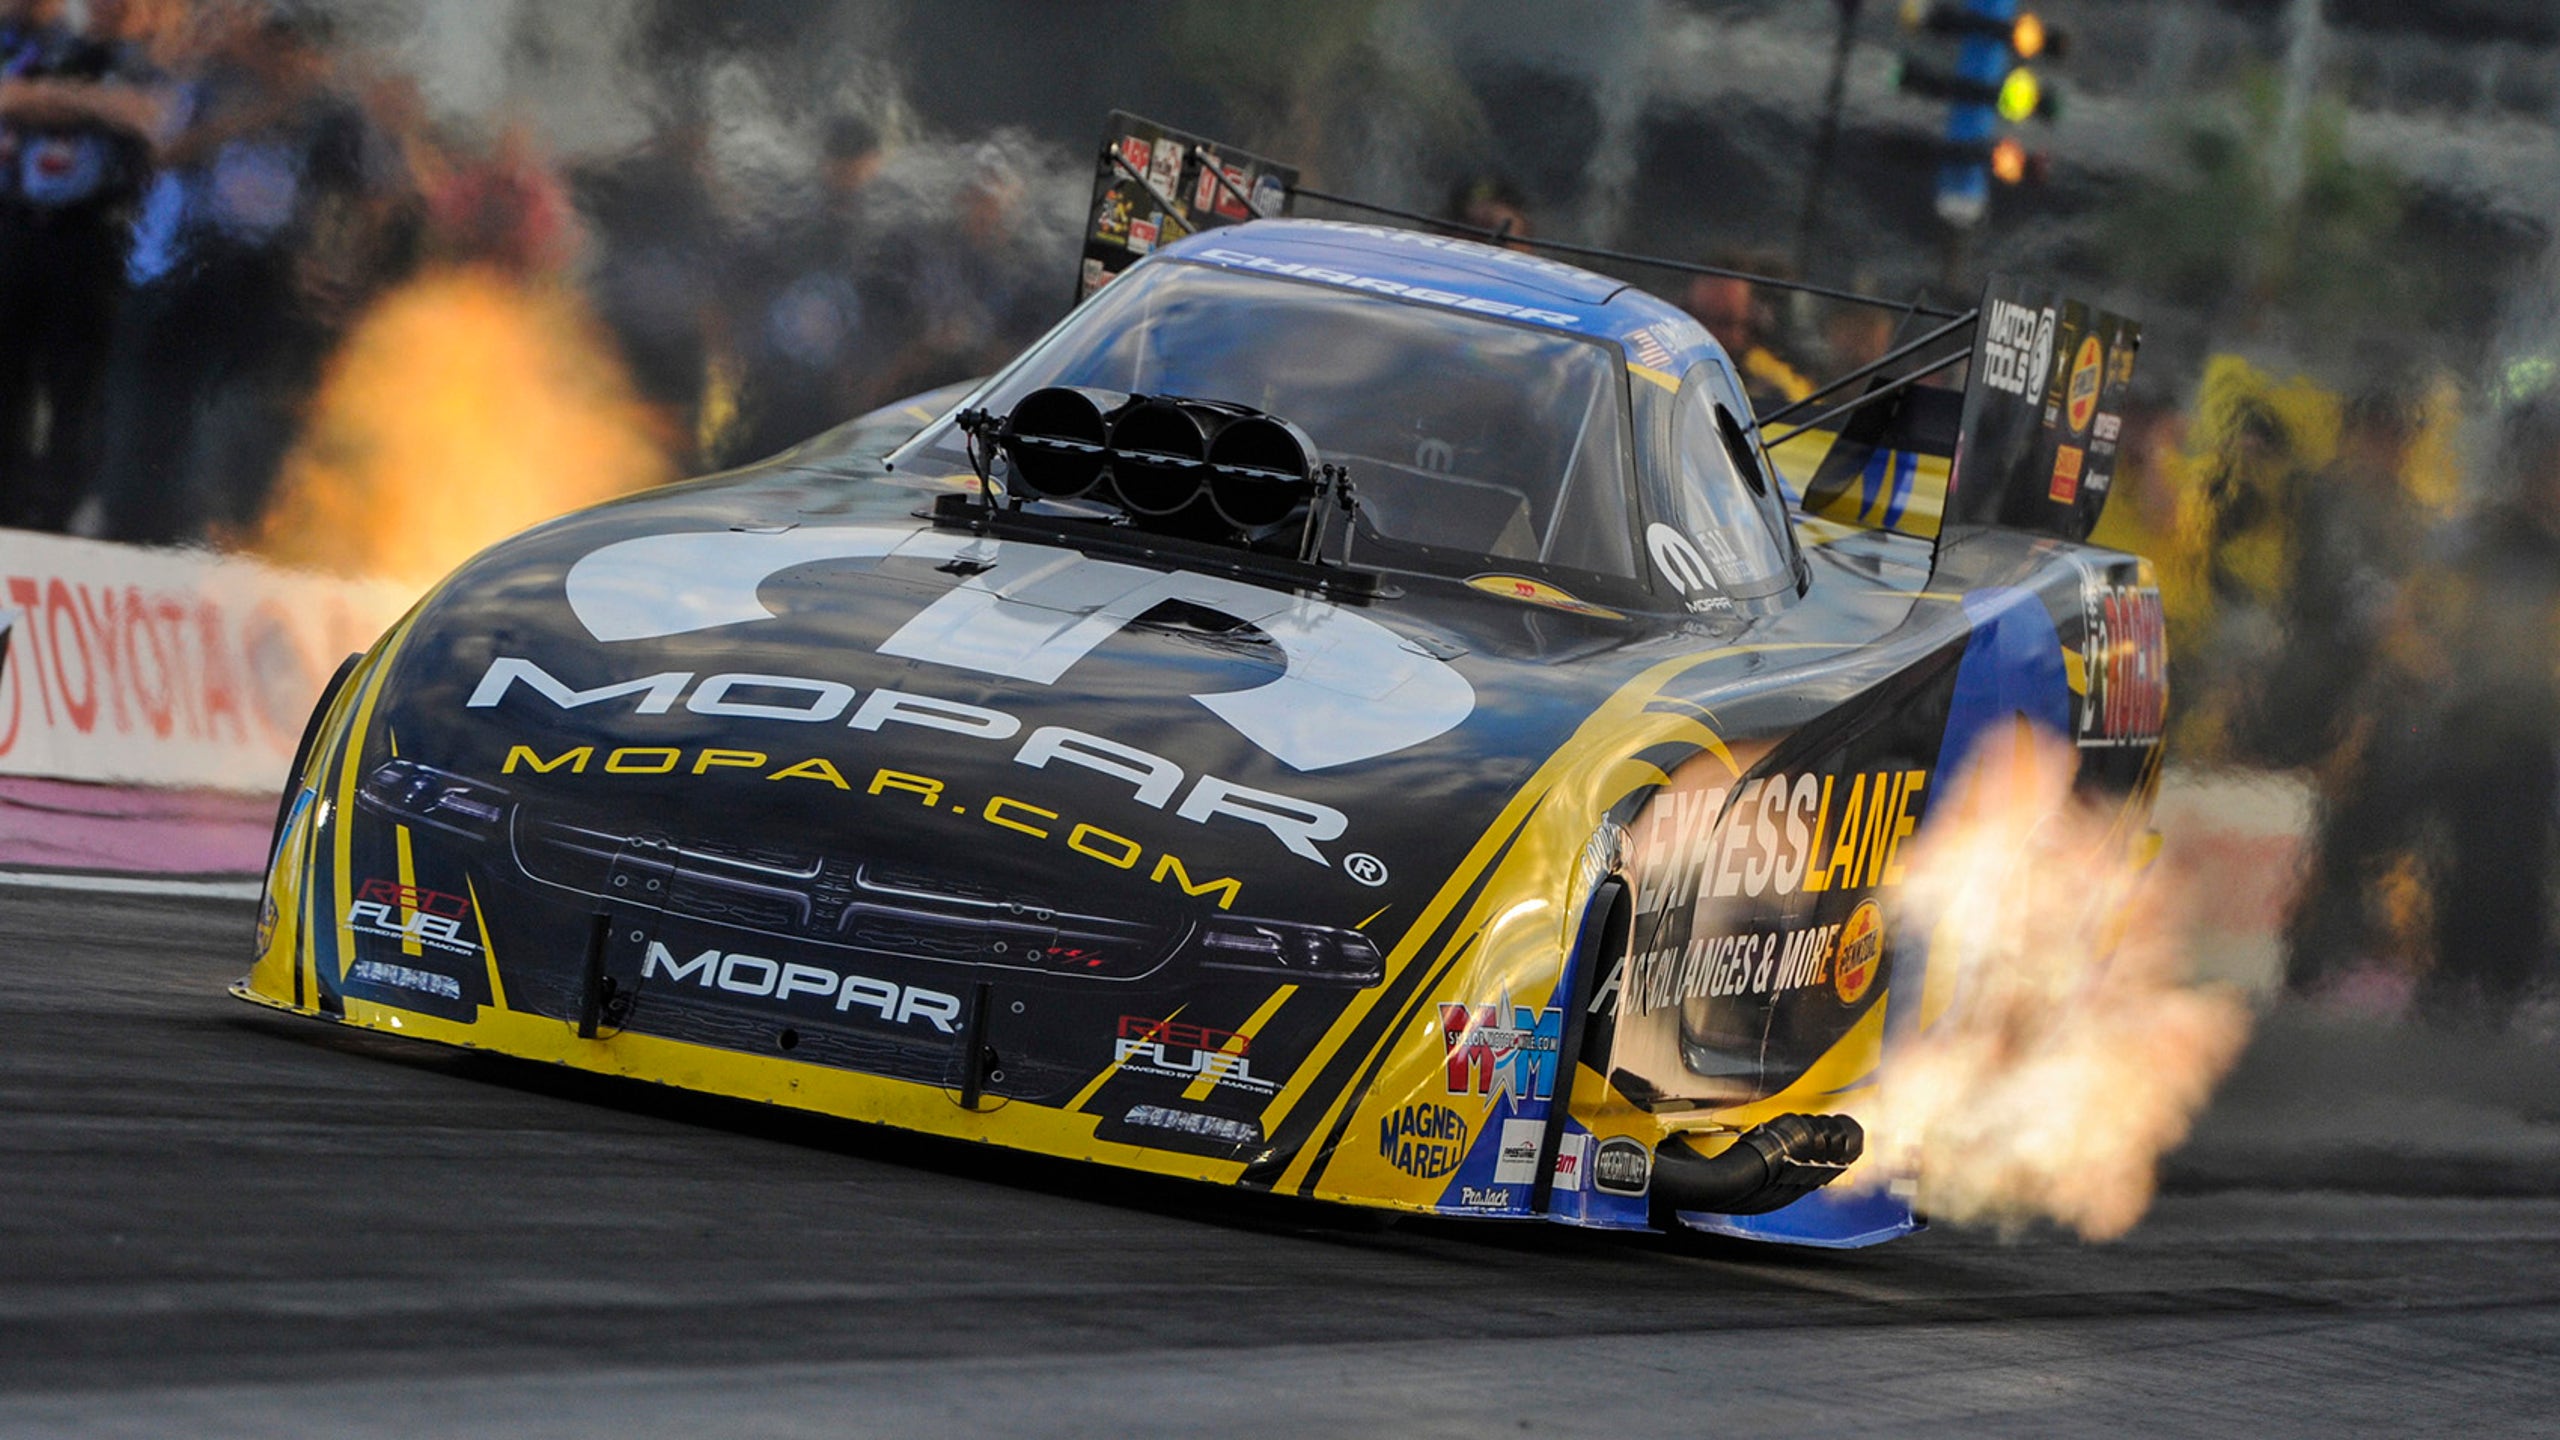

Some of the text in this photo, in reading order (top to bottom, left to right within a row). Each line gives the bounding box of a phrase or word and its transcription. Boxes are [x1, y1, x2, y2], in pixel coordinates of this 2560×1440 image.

[1200, 248, 1579, 325] CHARGER
[1987, 299, 2037, 351] MATCO
[1982, 341, 2030, 395] TOOLS
[1685, 597, 1733, 614] MOPAR
[8, 576, 250, 744] TOYOTA
[466, 657, 1349, 868] MOPAR
[501, 745, 1242, 910] MOPAR.COM
[347, 900, 477, 948] FUEL
[357, 878, 471, 920] RED
[1773, 923, 1841, 991] MORE
[641, 940, 961, 1034] MOPAR
[1117, 1014, 1250, 1056] RED
[1115, 1038, 1275, 1087] FUEL
[1115, 1063, 1175, 1077] POWERED
